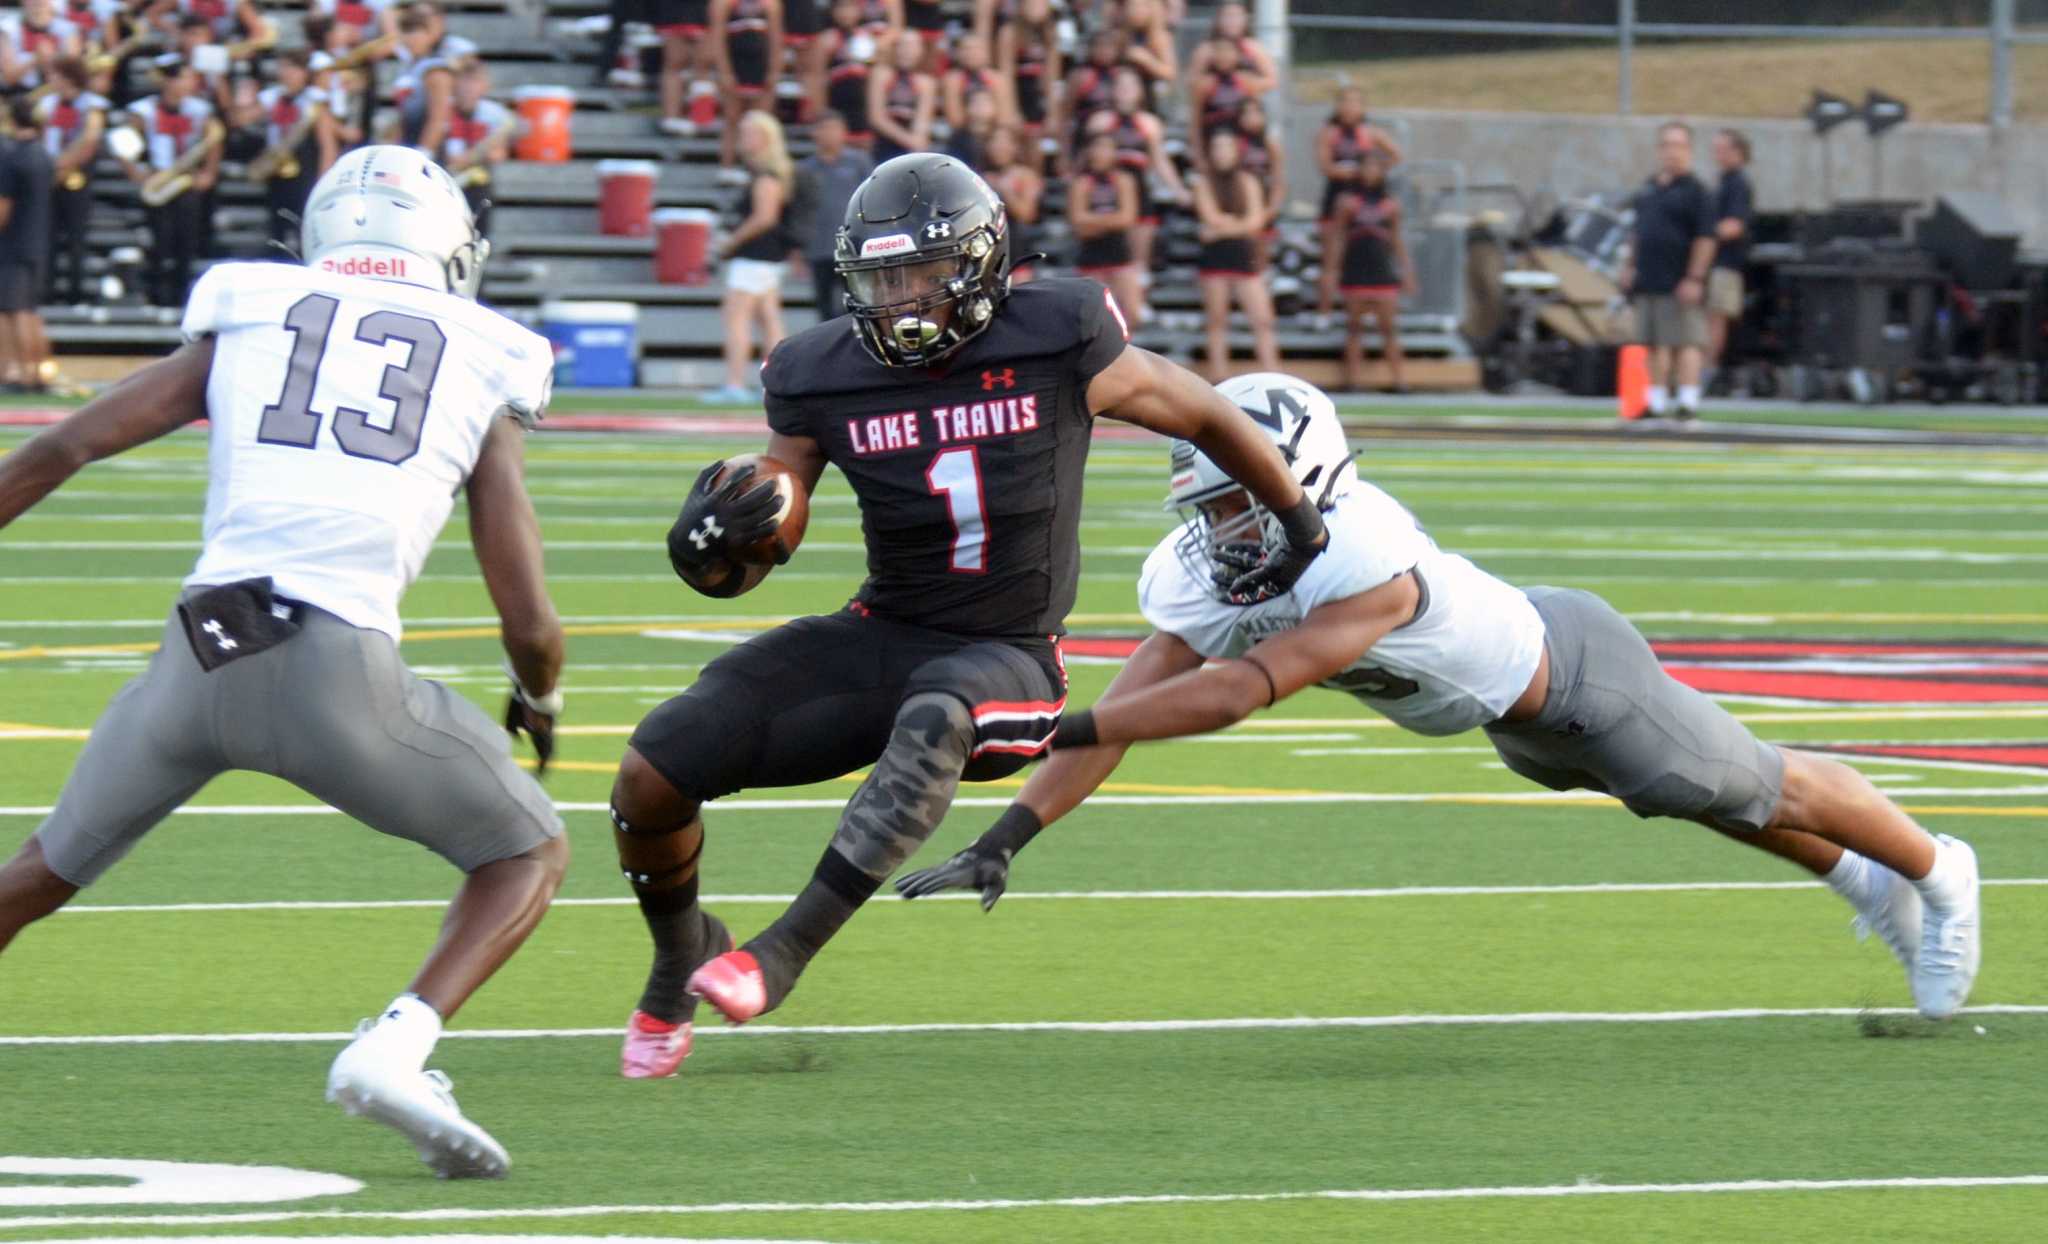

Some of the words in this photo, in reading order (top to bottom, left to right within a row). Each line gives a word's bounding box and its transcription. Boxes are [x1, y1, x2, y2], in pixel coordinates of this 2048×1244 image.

[866, 238, 906, 252] Riddell
[257, 293, 447, 465] 13
[849, 411, 920, 454] LAKE
[931, 394, 1039, 443] TRAVIS
[925, 444, 989, 575] 1
